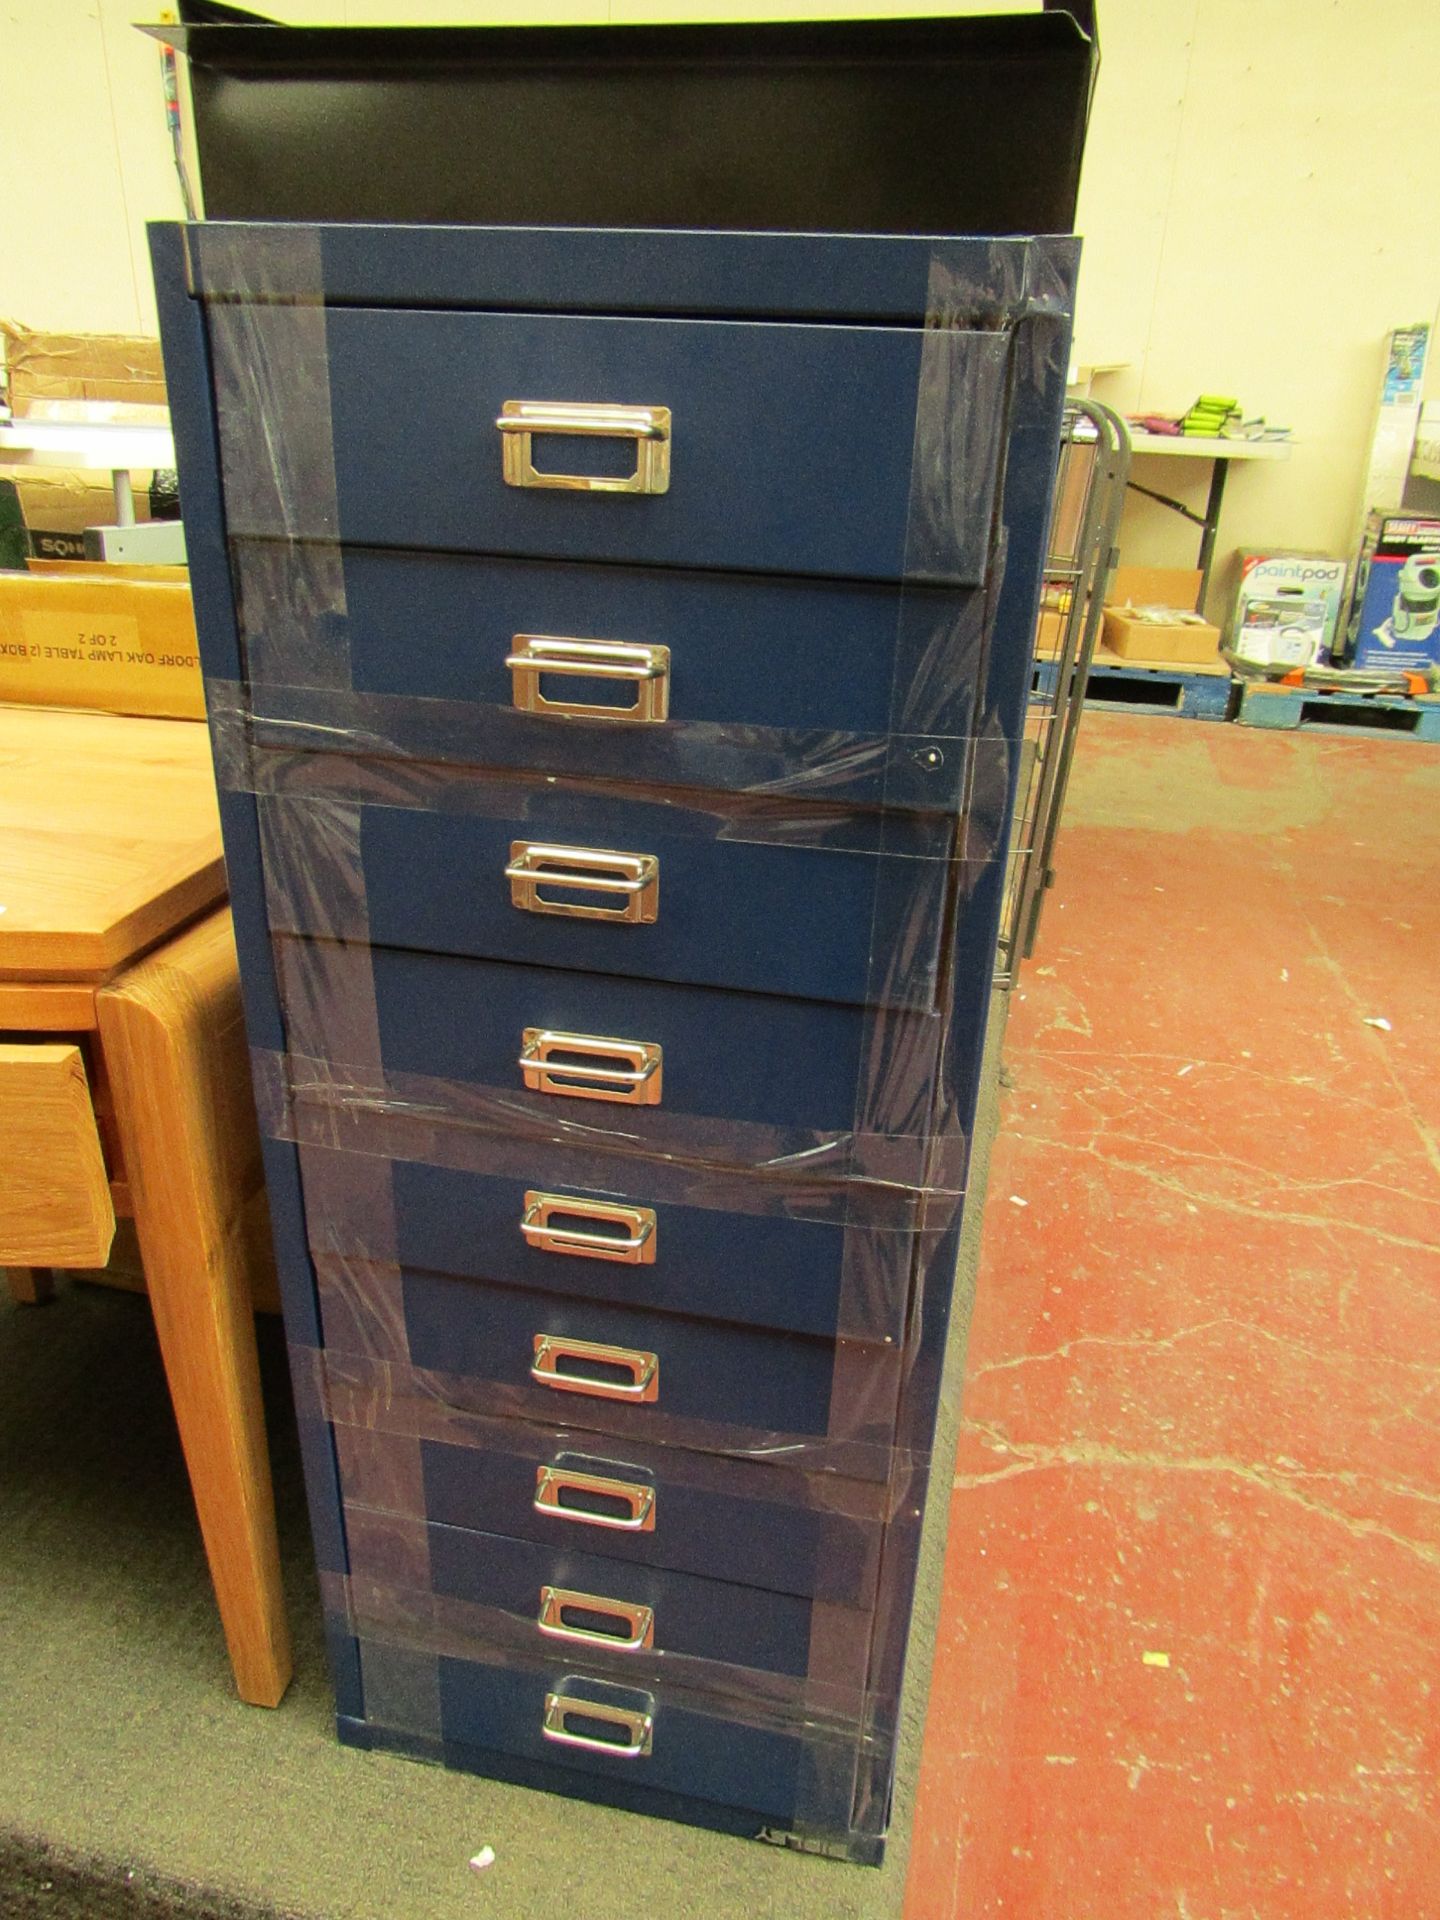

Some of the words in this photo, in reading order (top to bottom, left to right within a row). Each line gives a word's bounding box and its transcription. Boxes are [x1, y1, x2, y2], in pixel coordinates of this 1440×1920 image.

[1255, 565, 1339, 581] paintpod
[78, 633, 85, 644] 2
[89, 634, 106, 646] OF
[109, 635, 117, 646] 2
[44, 646, 84, 660] TABLE
[88, 649, 122, 661] LAMP
[126, 651, 154, 664] OAK
